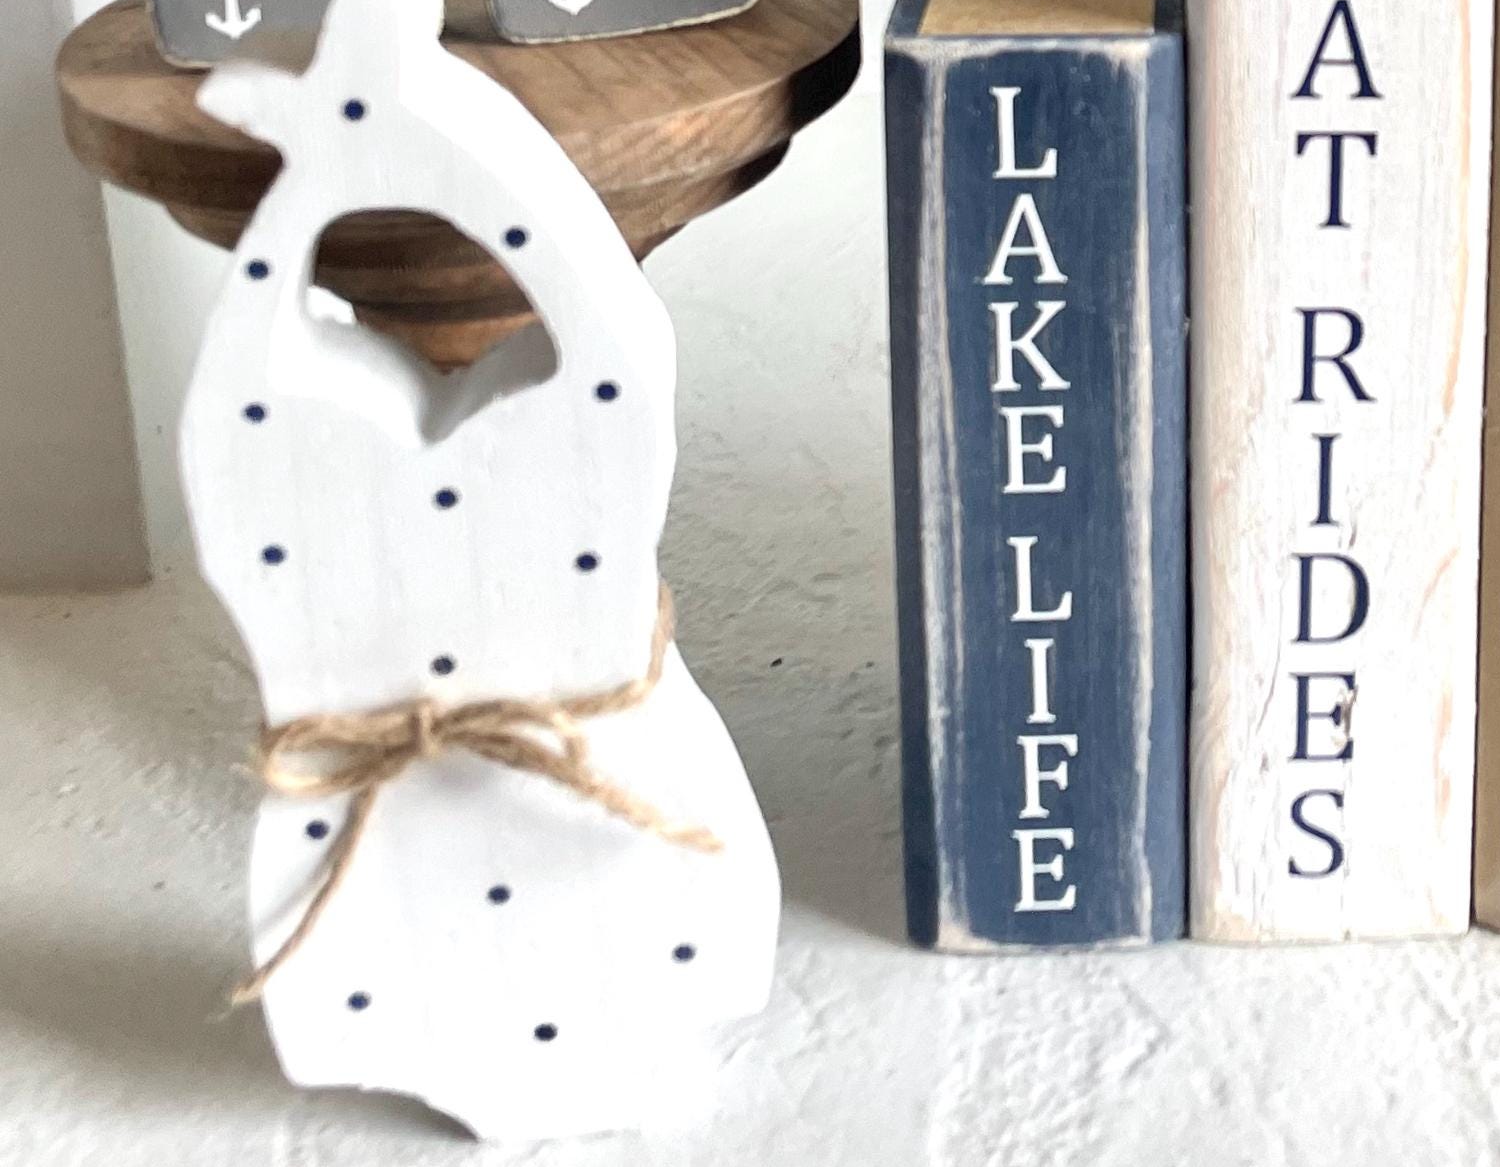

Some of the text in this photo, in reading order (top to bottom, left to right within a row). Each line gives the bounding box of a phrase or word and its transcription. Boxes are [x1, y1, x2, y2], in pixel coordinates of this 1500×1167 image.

[982, 85, 1079, 914] LAKE LIFE
[1288, 306, 1378, 879] RIDES
